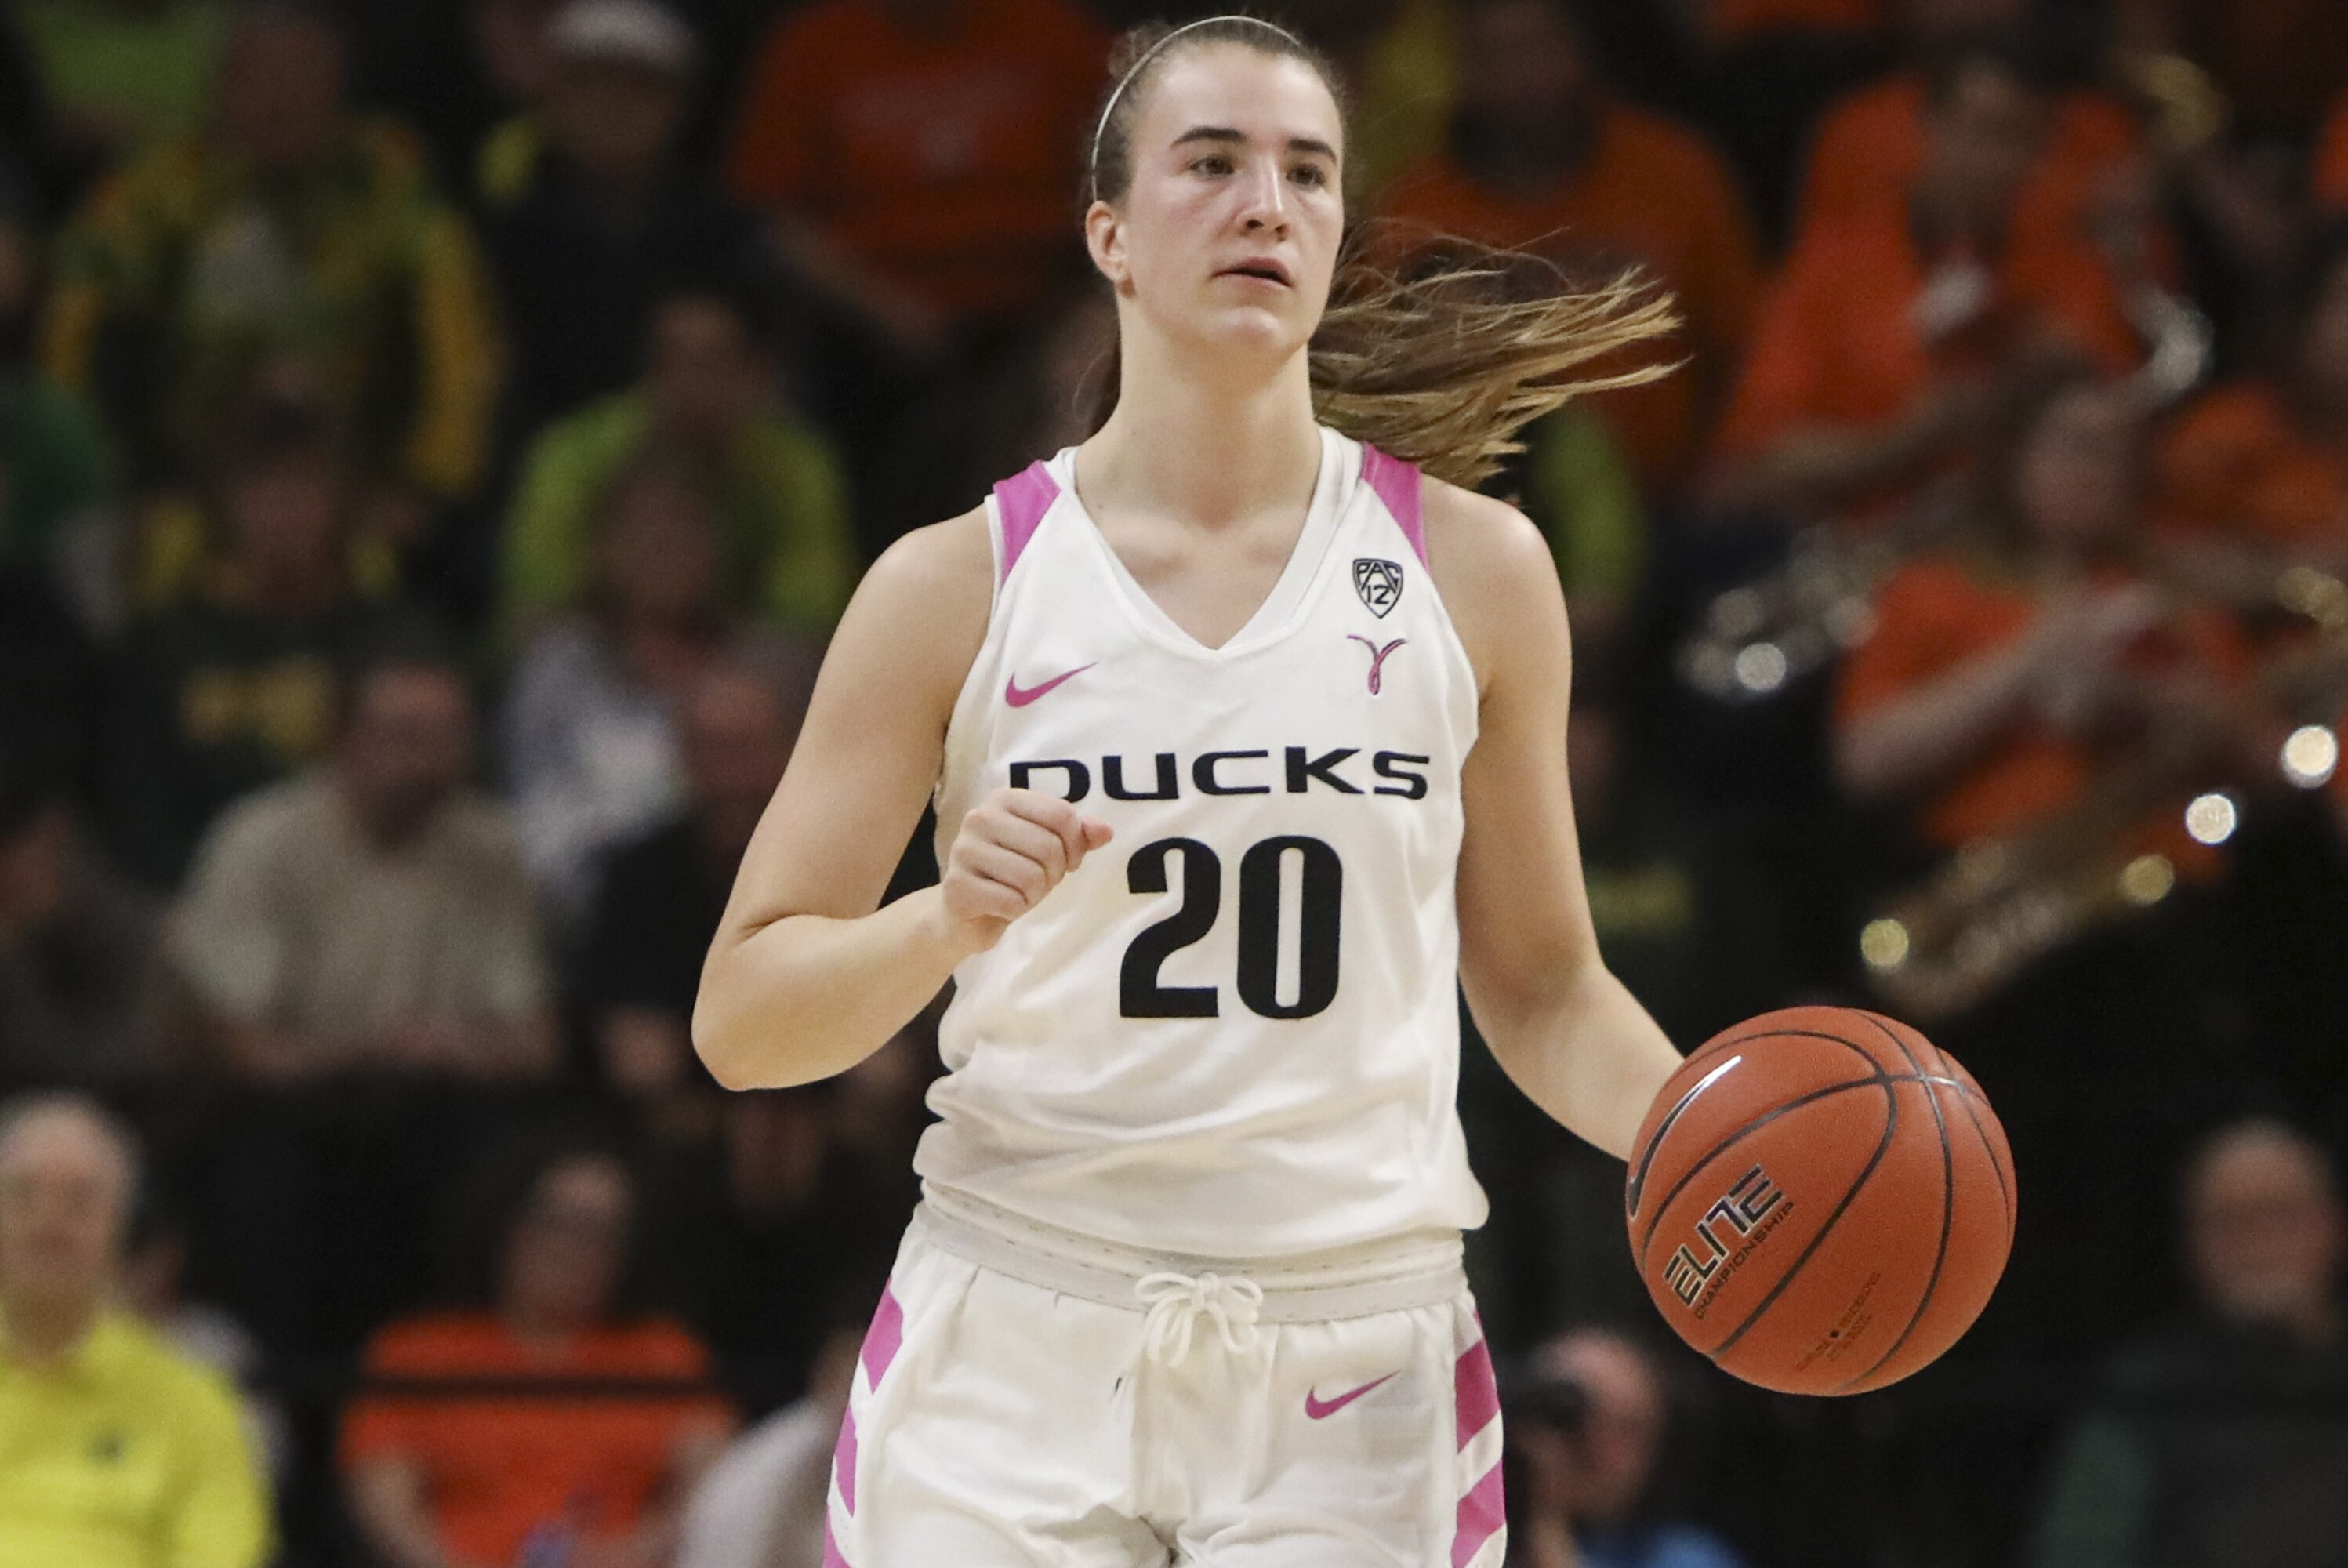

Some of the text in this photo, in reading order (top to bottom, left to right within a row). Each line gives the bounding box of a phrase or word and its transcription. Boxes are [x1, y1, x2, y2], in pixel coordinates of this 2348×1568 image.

[1356, 562, 1399, 594] PAC
[1366, 584, 1390, 604] 12
[1009, 746, 1430, 802] DUCKS
[1120, 835, 1343, 1019] 20
[1663, 1163, 1784, 1308] ELITE
[1694, 1201, 1795, 1319] CHAMPIONSHIP
